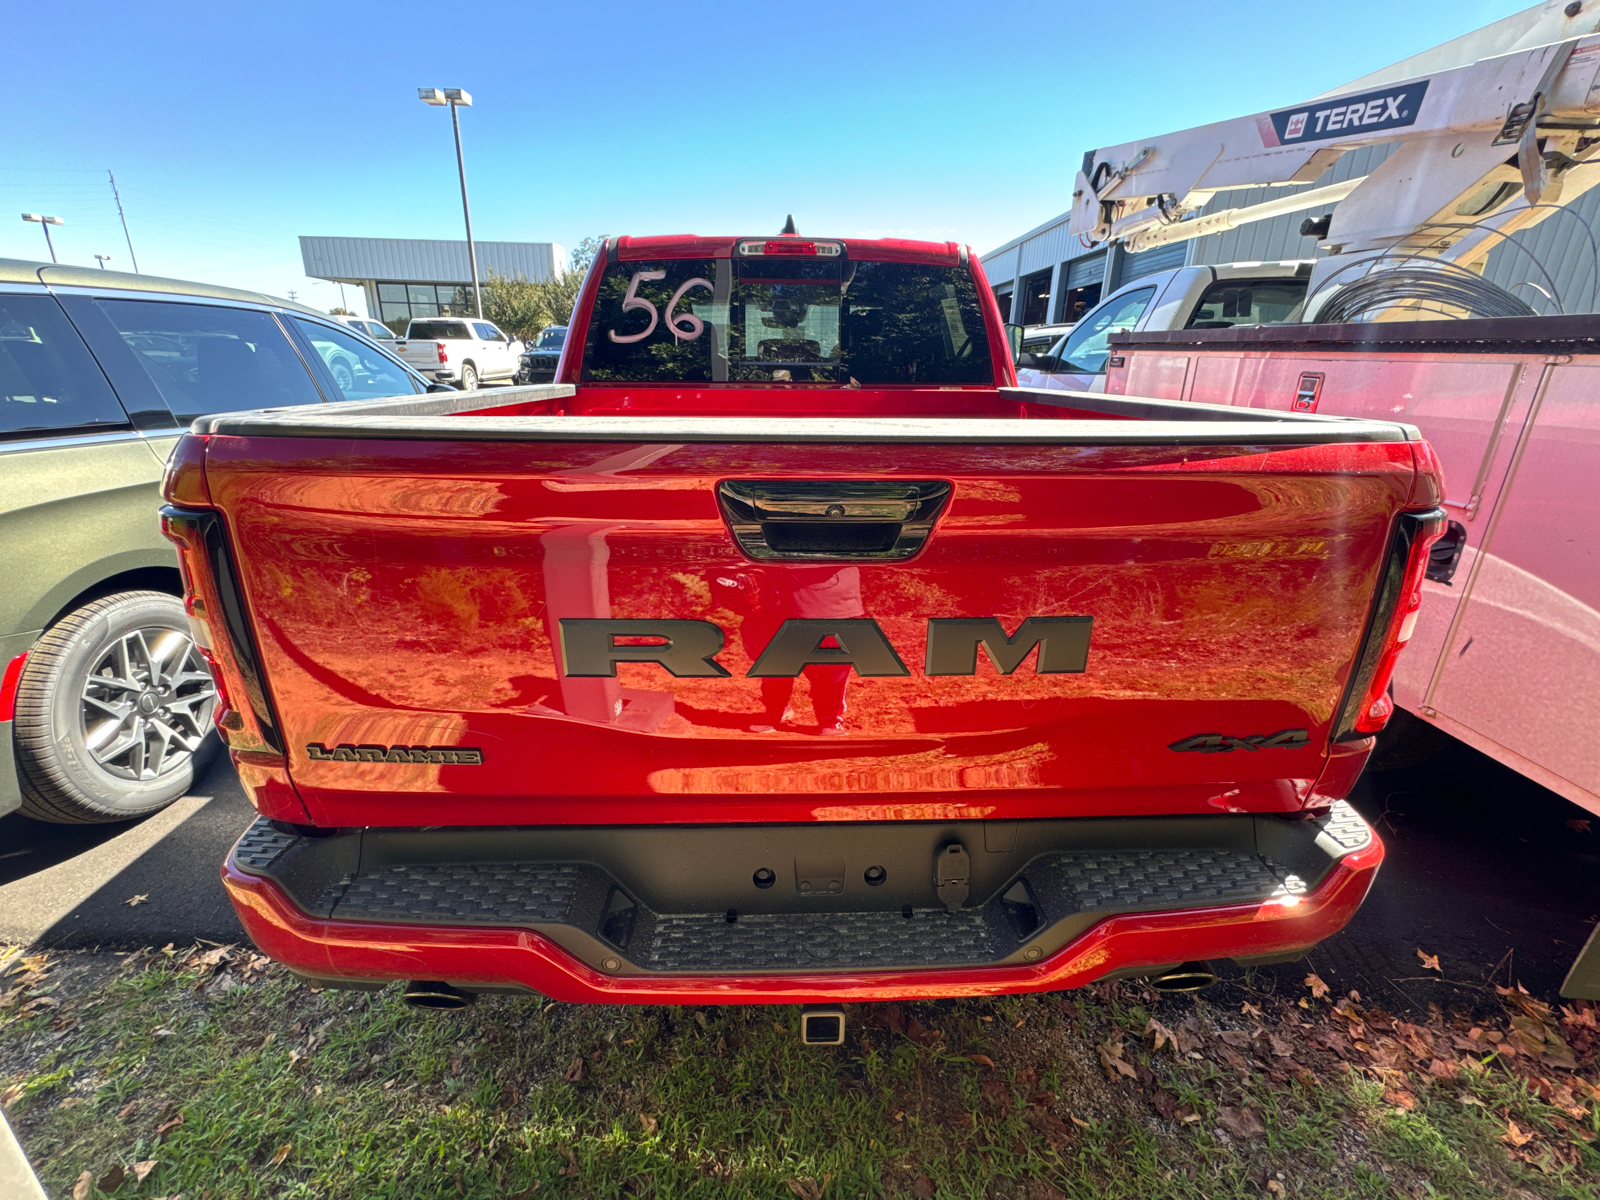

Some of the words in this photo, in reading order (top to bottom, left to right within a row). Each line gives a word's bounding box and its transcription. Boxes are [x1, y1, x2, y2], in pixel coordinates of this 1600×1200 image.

[608, 270, 715, 344] 56
[559, 616, 1094, 677] RAM
[306, 743, 485, 765] LARAMIE
